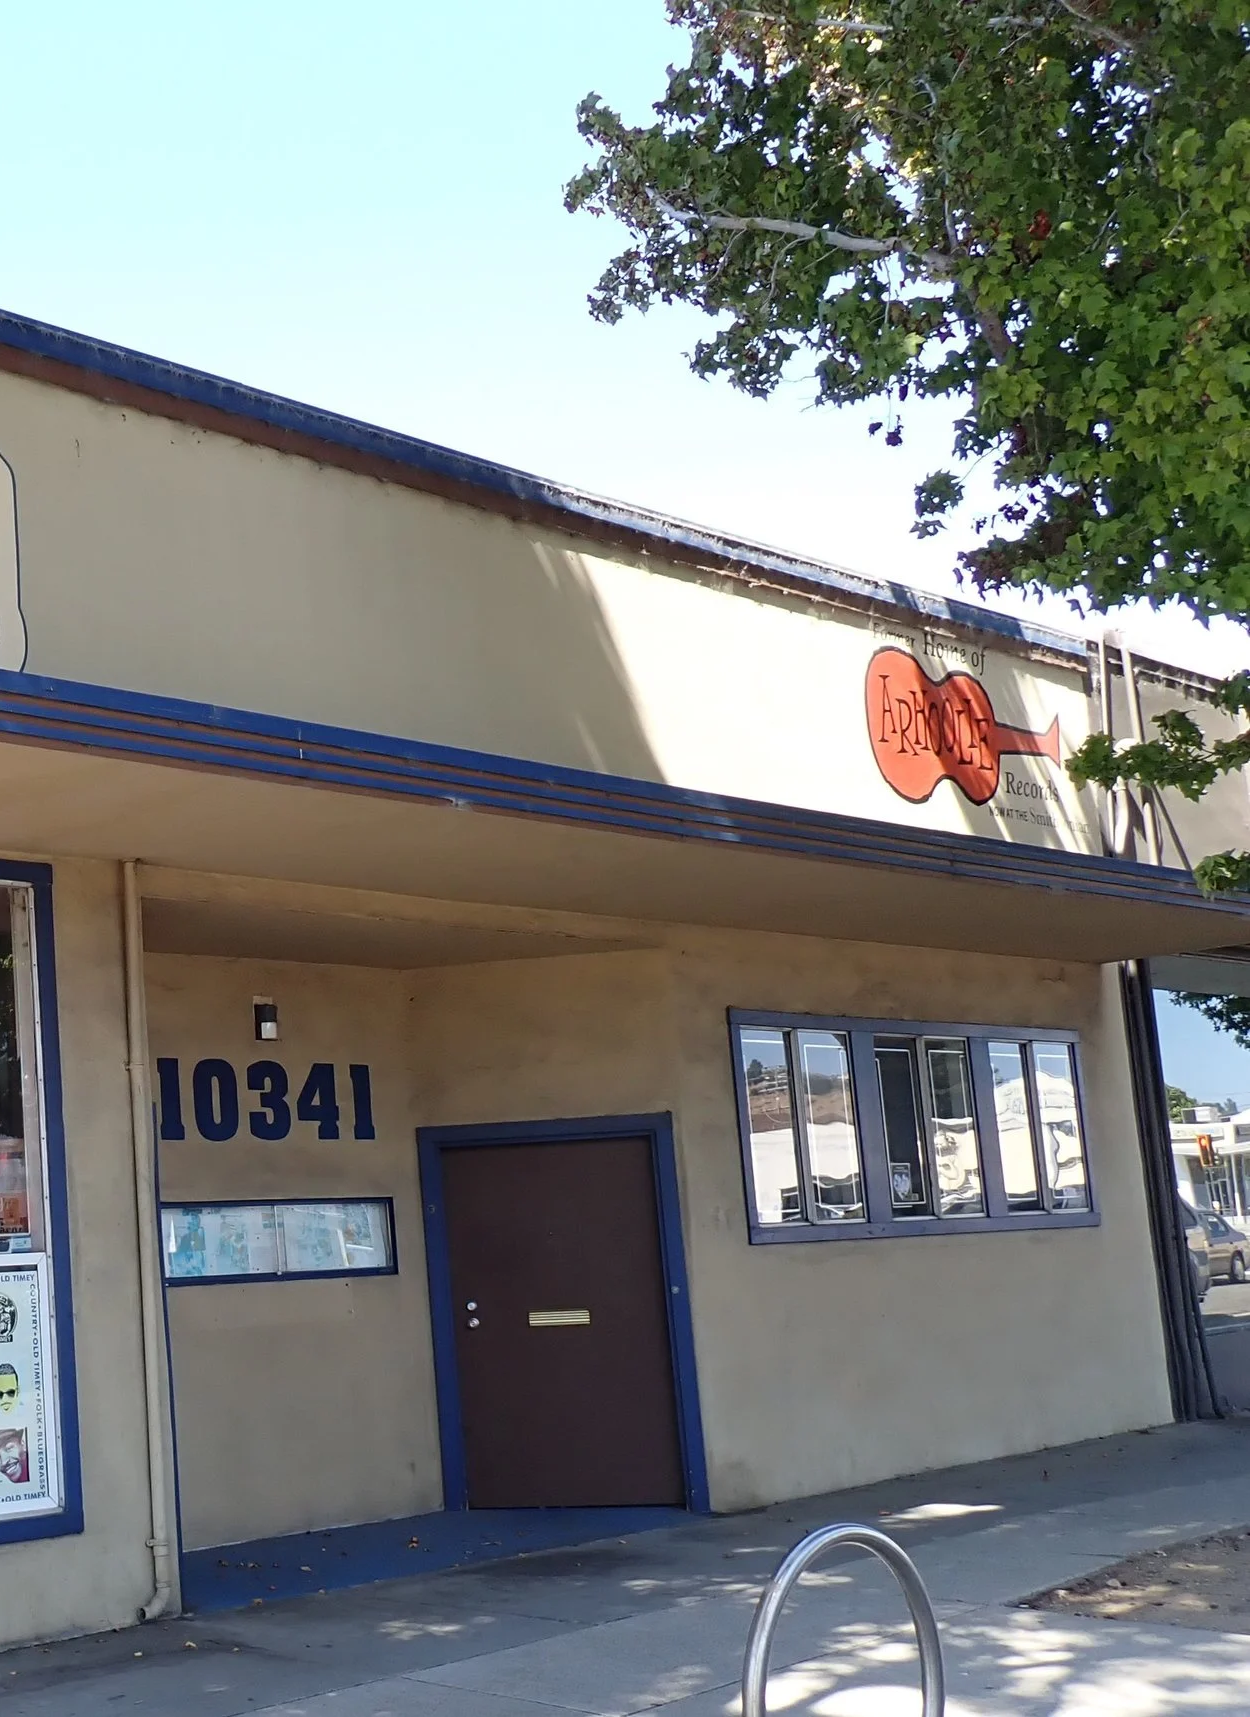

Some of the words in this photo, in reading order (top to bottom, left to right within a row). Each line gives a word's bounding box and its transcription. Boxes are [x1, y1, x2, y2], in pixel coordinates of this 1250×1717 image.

[873, 621, 916, 649] Former
[923, 632, 966, 664] Home
[972, 647, 986, 675] of
[1005, 772, 1059, 801] Records
[1006, 808, 1013, 819] AT
[1015, 809, 1028, 822] THE
[157, 1058, 376, 1141] 10341
[12, 1274, 35, 1282] TIMEY
[30, 1283, 38, 1330] COUNTRY
[33, 1362, 41, 1391] TIMEY
[37, 1431, 46, 1492] BLUEGRASS
[24, 1491, 46, 1500] TIMEY
